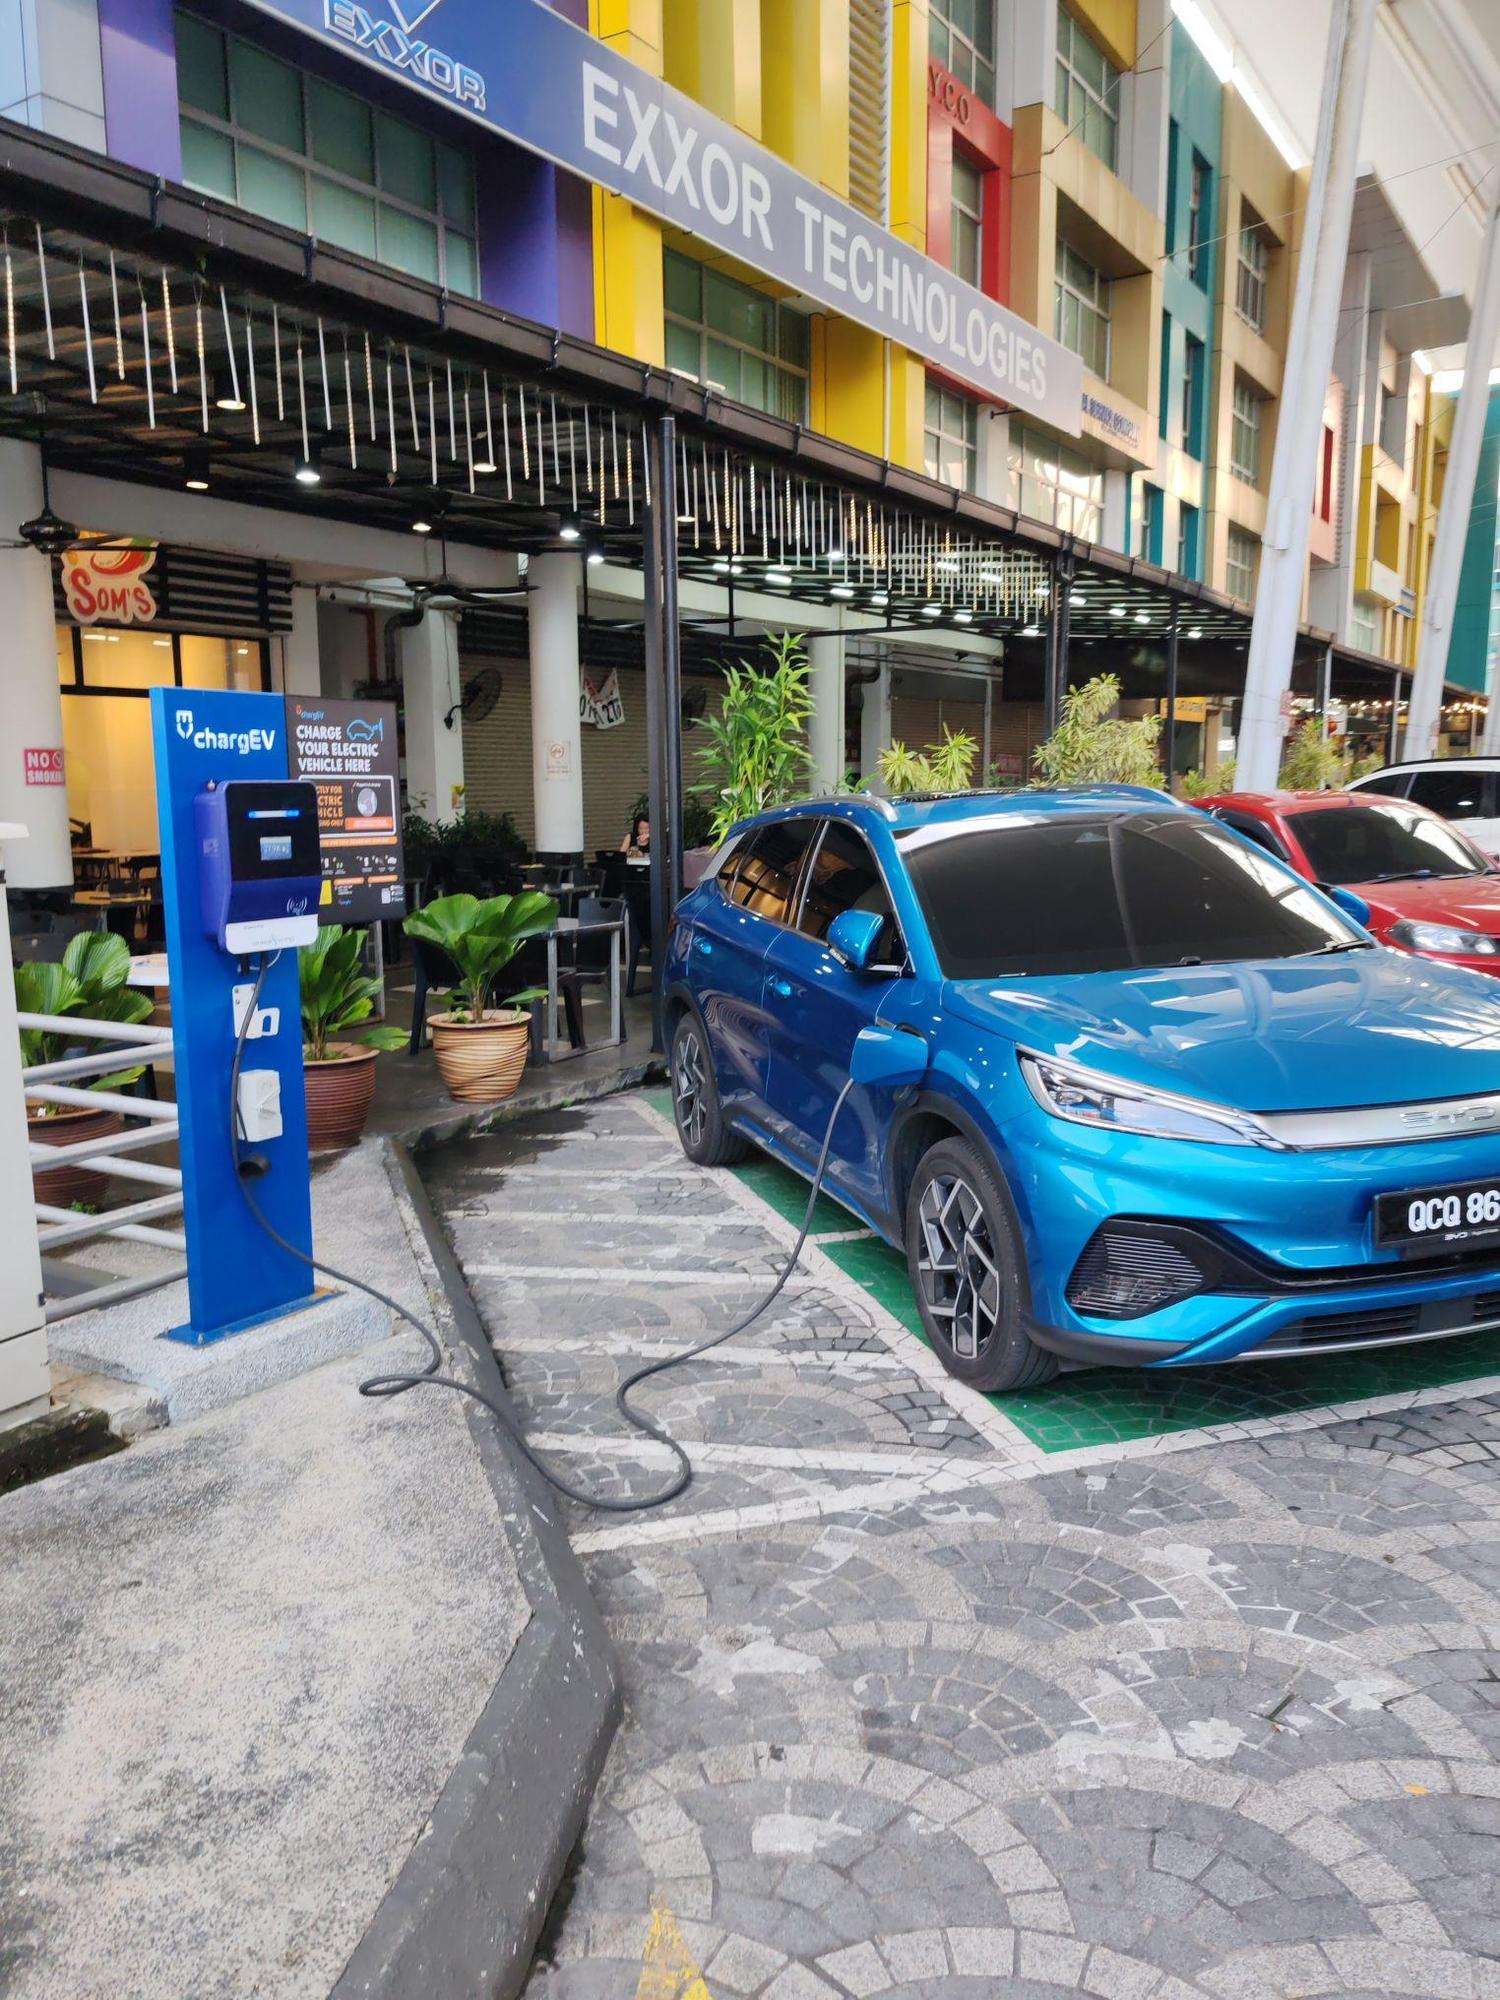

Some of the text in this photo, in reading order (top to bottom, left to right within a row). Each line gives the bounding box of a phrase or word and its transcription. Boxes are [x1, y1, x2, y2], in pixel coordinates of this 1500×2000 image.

[323, 0, 486, 112] EXXOR
[582, 61, 1046, 401] EXXOR TECHNOLOGIES
[193, 727, 275, 754] chargEV
[296, 725, 342, 740] CHARGE
[297, 741, 379, 757] YOUR ELECTRIC
[28, 752, 50, 768] NO
[297, 758, 371, 772] VEHICLE HERE
[1408, 1190, 1500, 1232] QCQ 86
